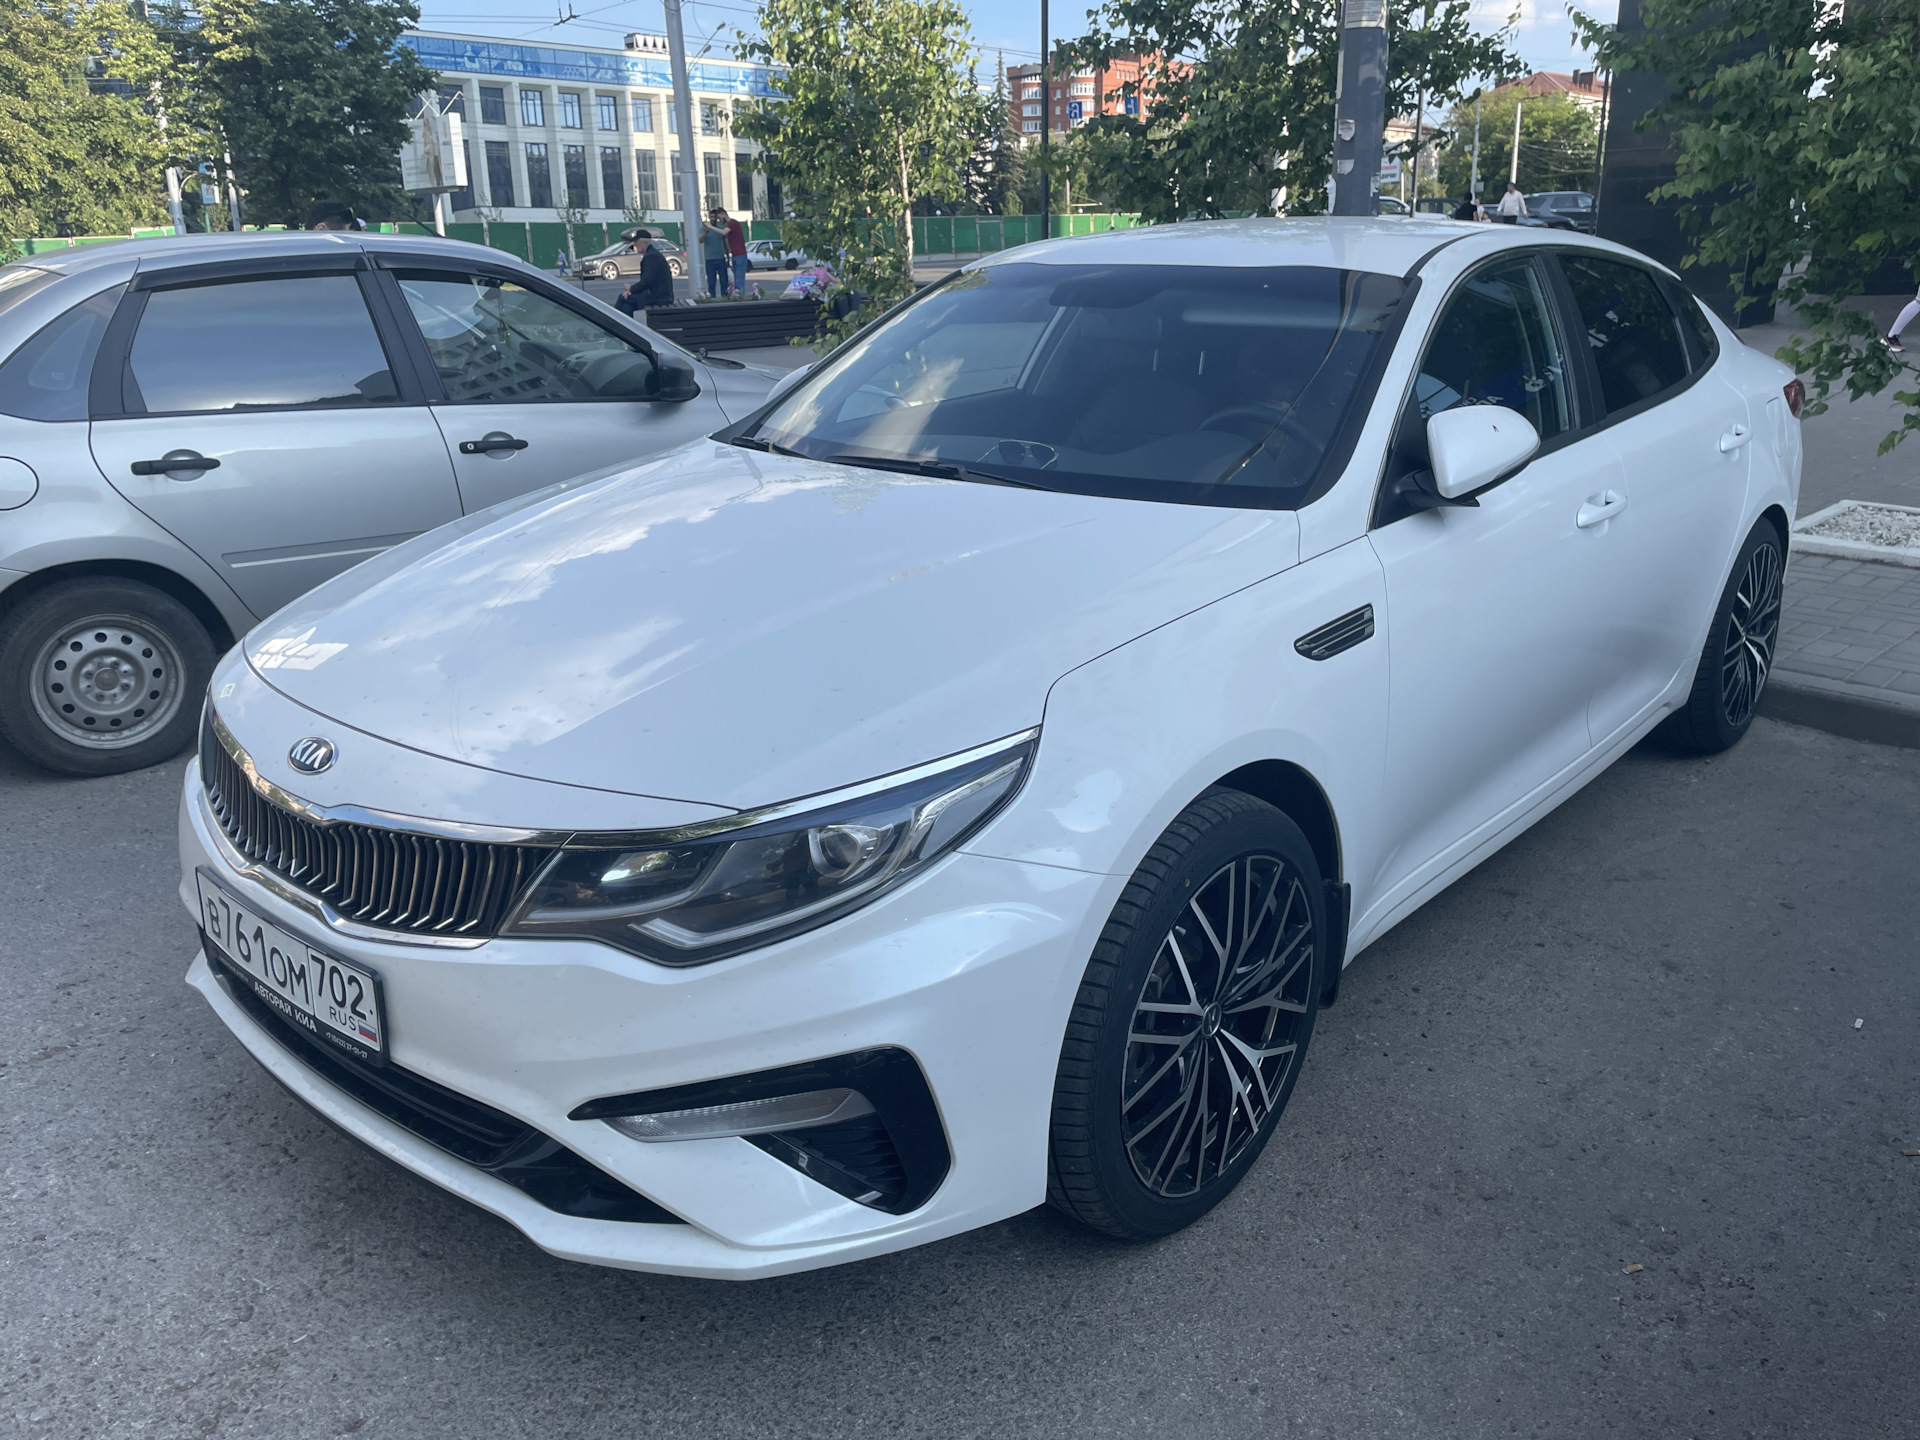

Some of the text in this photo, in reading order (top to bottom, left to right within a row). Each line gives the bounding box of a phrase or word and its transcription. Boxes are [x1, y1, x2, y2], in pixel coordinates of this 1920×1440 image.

[291, 740, 327, 769] KIA
[254, 981, 318, 1033] АВТОРАЙ КИА
[329, 1006, 357, 1031] RUS
